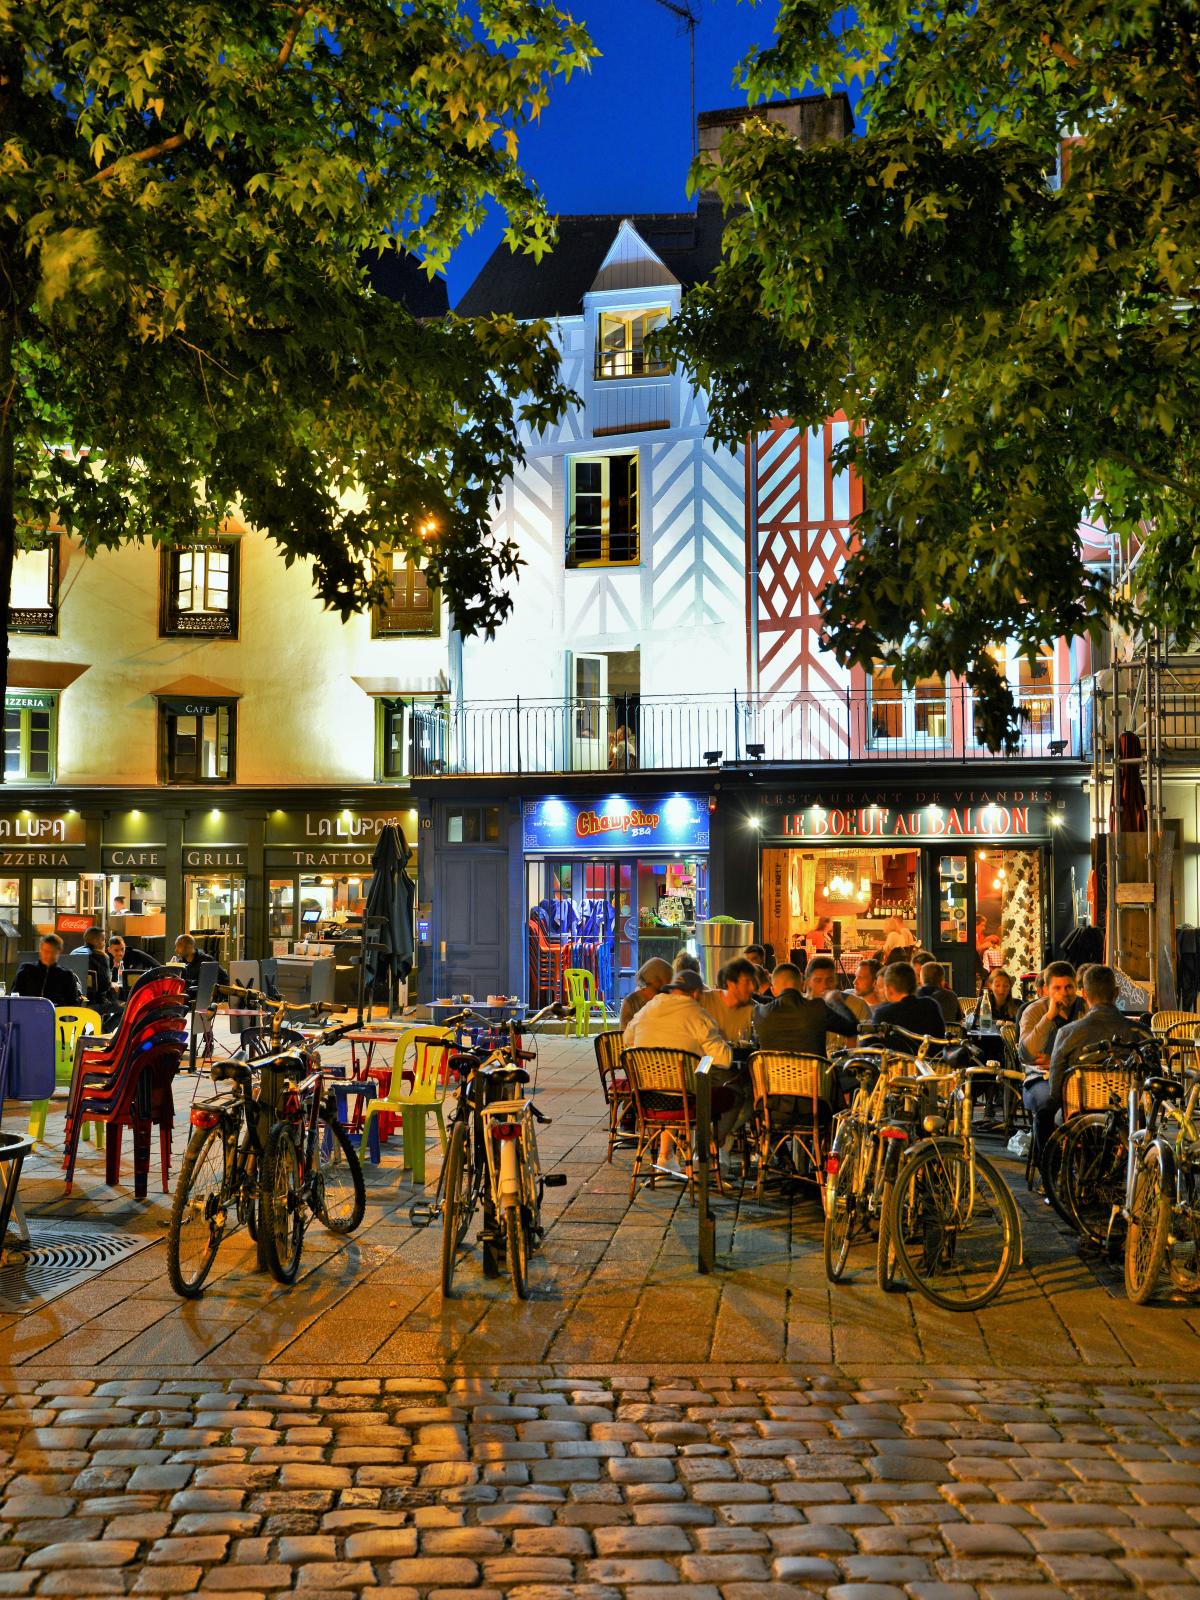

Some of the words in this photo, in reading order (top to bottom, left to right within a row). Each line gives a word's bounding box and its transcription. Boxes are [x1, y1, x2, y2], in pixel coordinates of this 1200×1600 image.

[5, 698, 44, 707] IZZERIA
[185, 704, 211, 714] CAFE
[760, 792, 903, 804] RESTAURANT
[916, 791, 941, 802] DE
[954, 790, 1053, 802] VIANDES
[306, 813, 332, 836] LA
[421, 819, 431, 829] 10
[783, 814, 805, 836] LE
[893, 813, 921, 836] AU
[926, 805, 1030, 836] BALCON
[0, 819, 11, 837] A
[15, 818, 65, 842] LUPA
[631, 827, 651, 838] BBQ
[3, 853, 70, 866] ZZERIA
[111, 851, 158, 865] CAFE
[187, 851, 244, 866] GRILL
